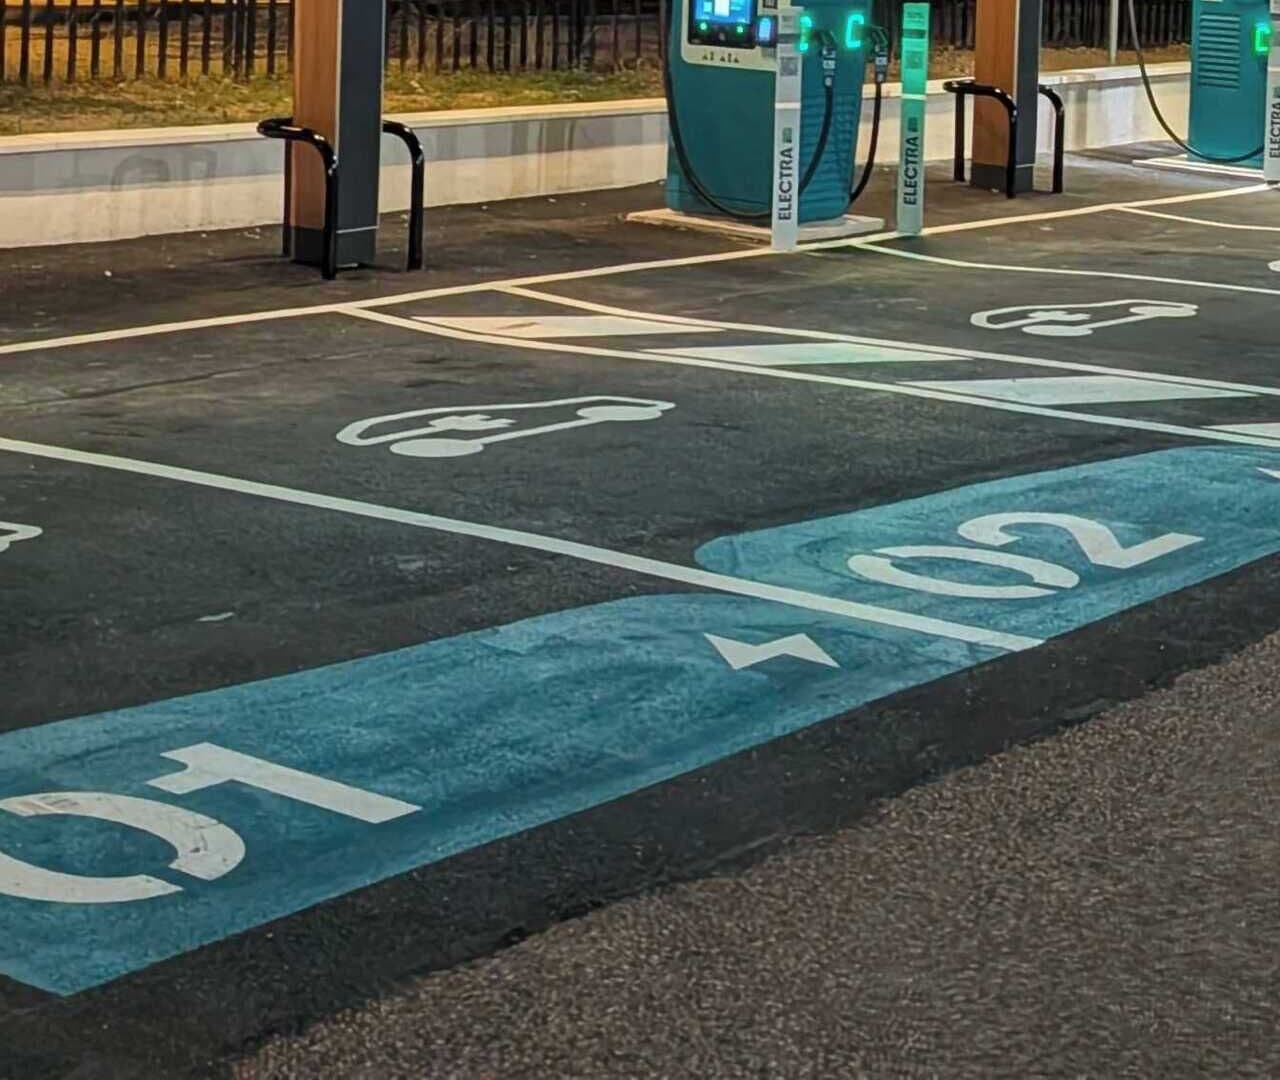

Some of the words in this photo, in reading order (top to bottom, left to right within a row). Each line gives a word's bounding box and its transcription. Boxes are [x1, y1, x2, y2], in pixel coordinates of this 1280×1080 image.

[778, 144, 793, 220] ELECTRA
[904, 136, 919, 205] ELECTRA
[847, 511, 1205, 600] 02
